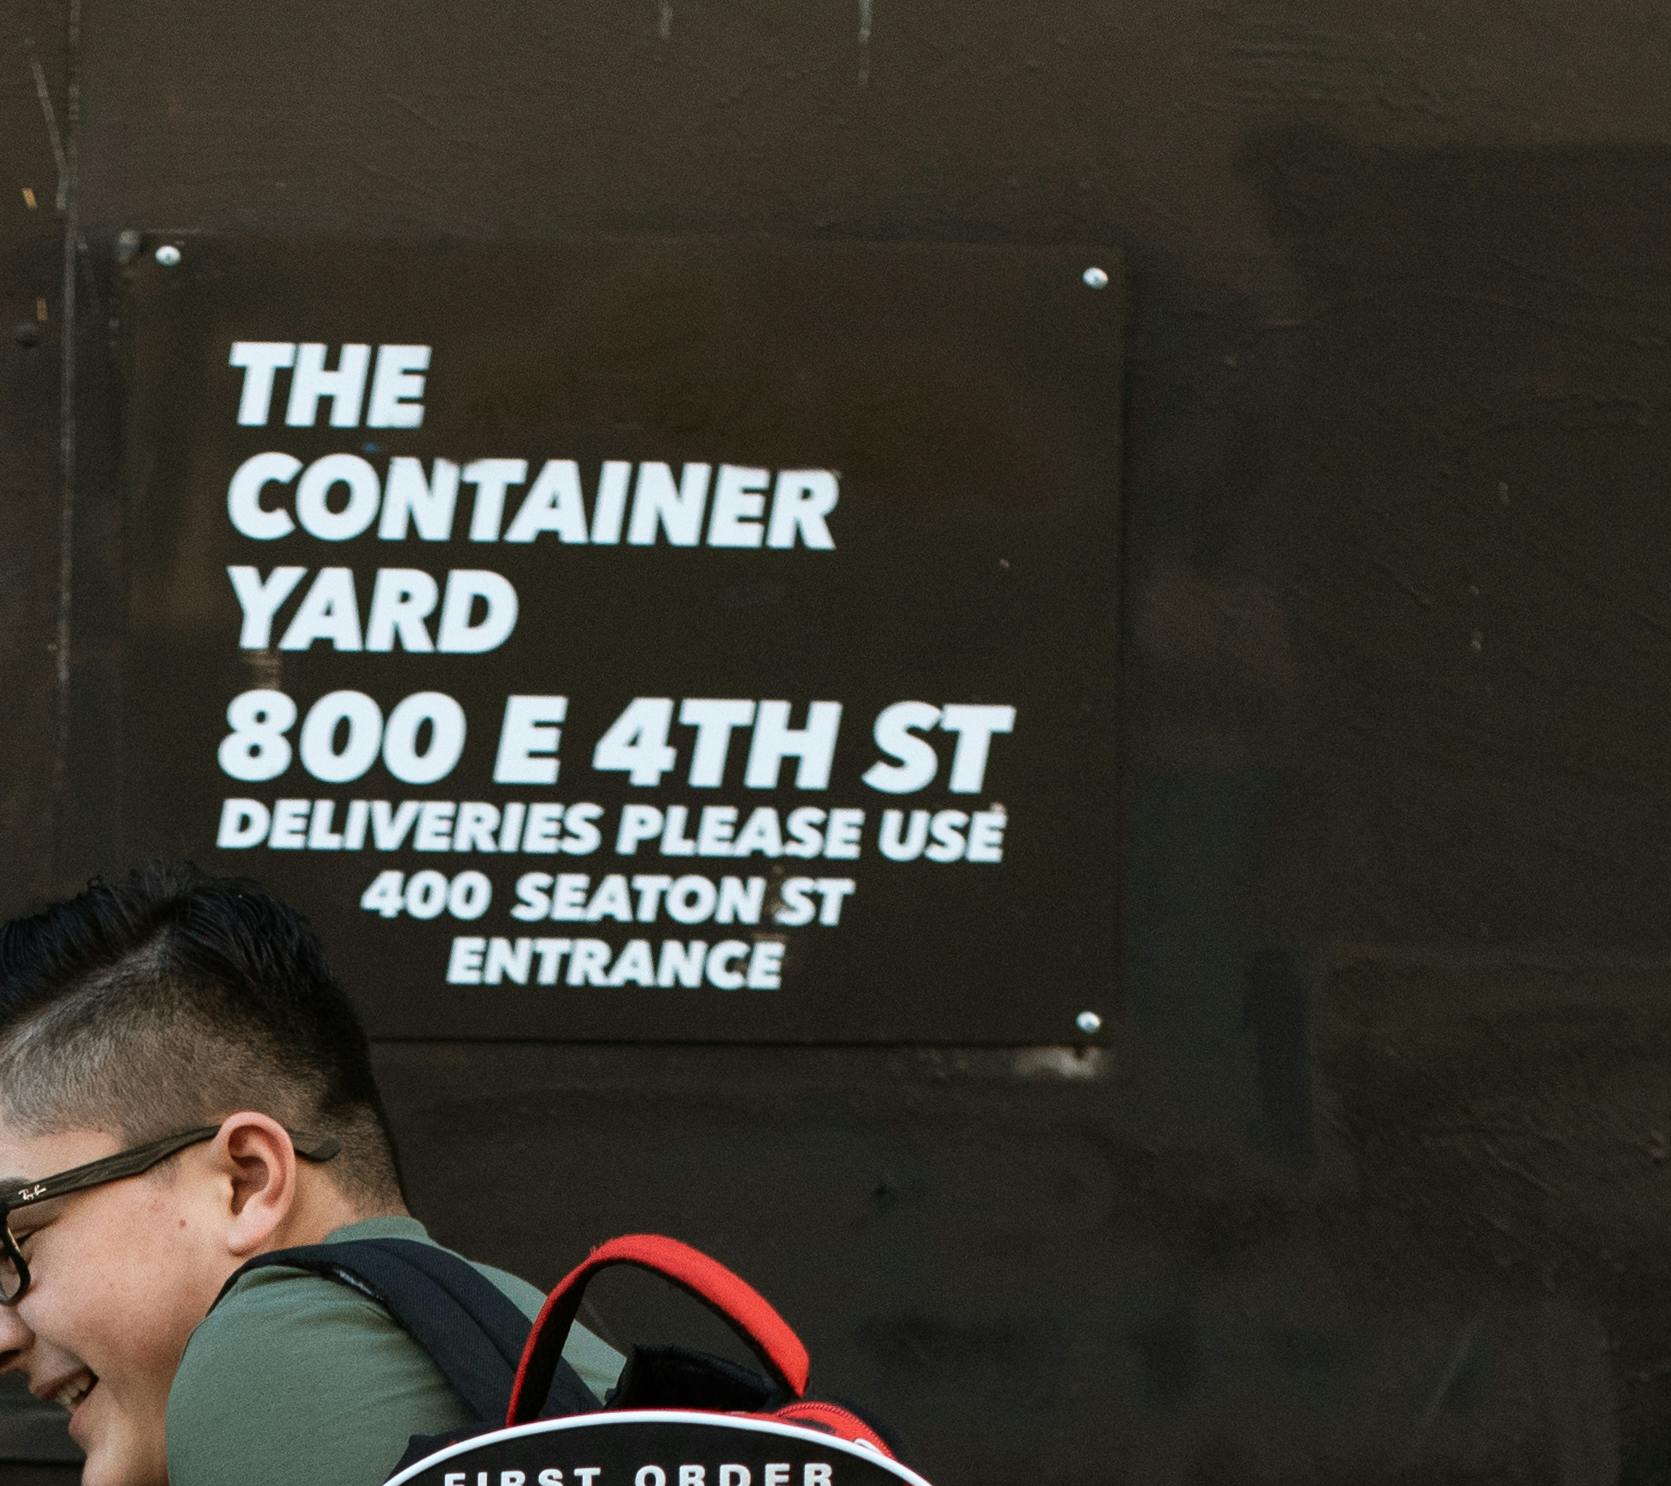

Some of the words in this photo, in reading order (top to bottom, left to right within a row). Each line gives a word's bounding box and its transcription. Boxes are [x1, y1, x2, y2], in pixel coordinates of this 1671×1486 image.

[228, 341, 431, 428] THE
[227, 451, 839, 550] CONTAINER
[227, 565, 519, 654] YARD
[218, 688, 466, 784] 800
[493, 694, 568, 785] E
[592, 697, 843, 790] 4TH
[862, 700, 1017, 794] ST
[216, 798, 604, 855] DELIVERIES
[616, 804, 865, 859] PLEASE
[879, 804, 1007, 862] USE
[360, 870, 492, 920] 400
[510, 871, 767, 924] SEATON
[774, 876, 856, 926] ST
[446, 936, 786, 990] ENTRANCE
